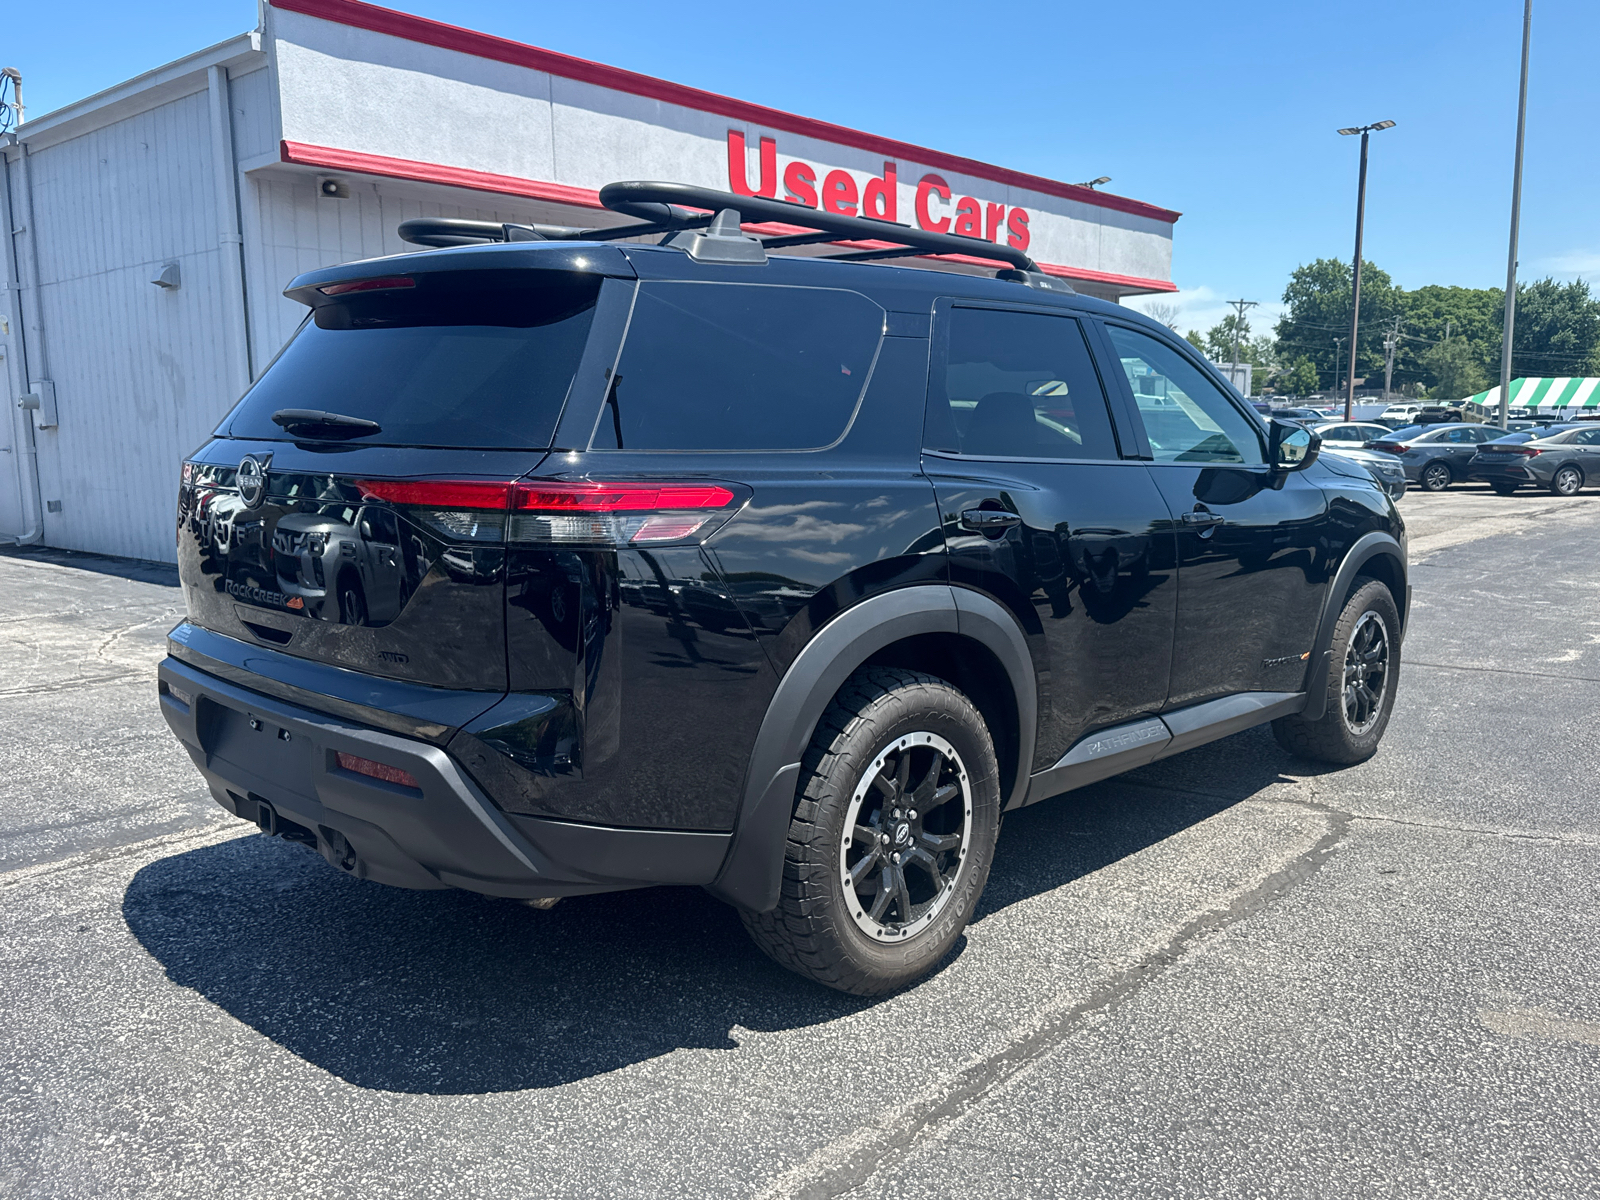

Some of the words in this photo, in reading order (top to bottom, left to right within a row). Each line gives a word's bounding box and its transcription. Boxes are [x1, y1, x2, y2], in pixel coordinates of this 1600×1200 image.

[727, 129, 898, 223] Used
[915, 173, 1030, 252] Cars
[178, 513, 396, 568] PATHFINDER
[224, 578, 251, 597] ROCK
[252, 588, 288, 606] CREEK
[1086, 724, 1167, 755] PATHFINDER
